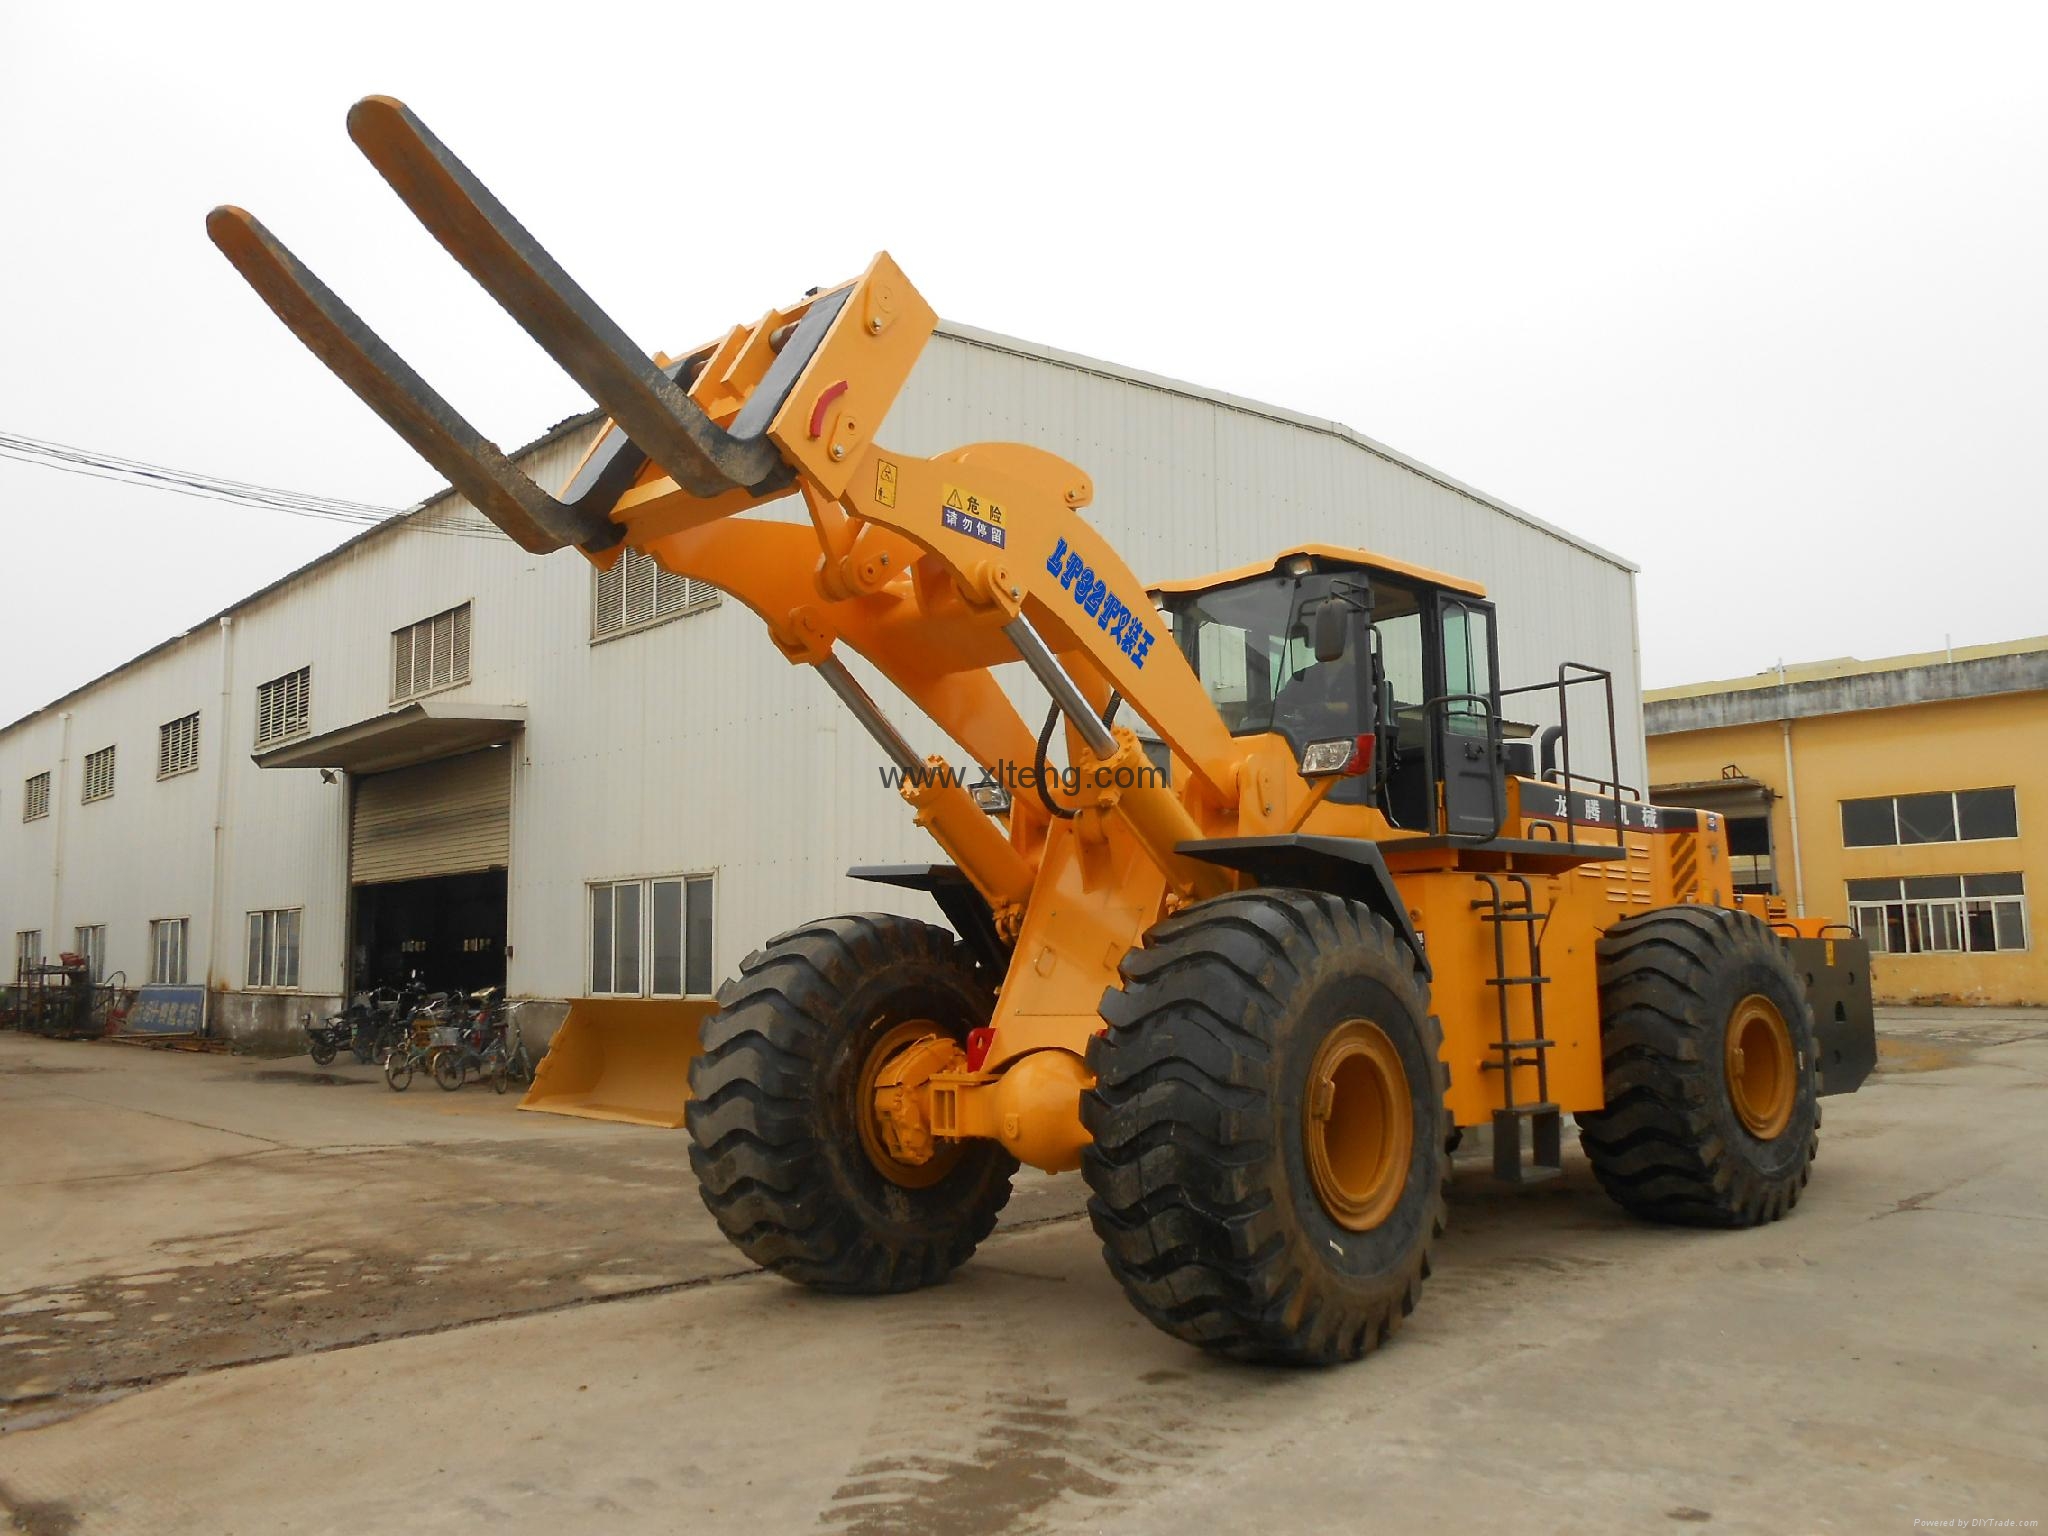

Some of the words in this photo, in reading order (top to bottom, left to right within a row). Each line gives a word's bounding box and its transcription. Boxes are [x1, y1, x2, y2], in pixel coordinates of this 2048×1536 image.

[967, 496, 1002, 524] 危险
[945, 509, 1002, 545] 请勿停留
